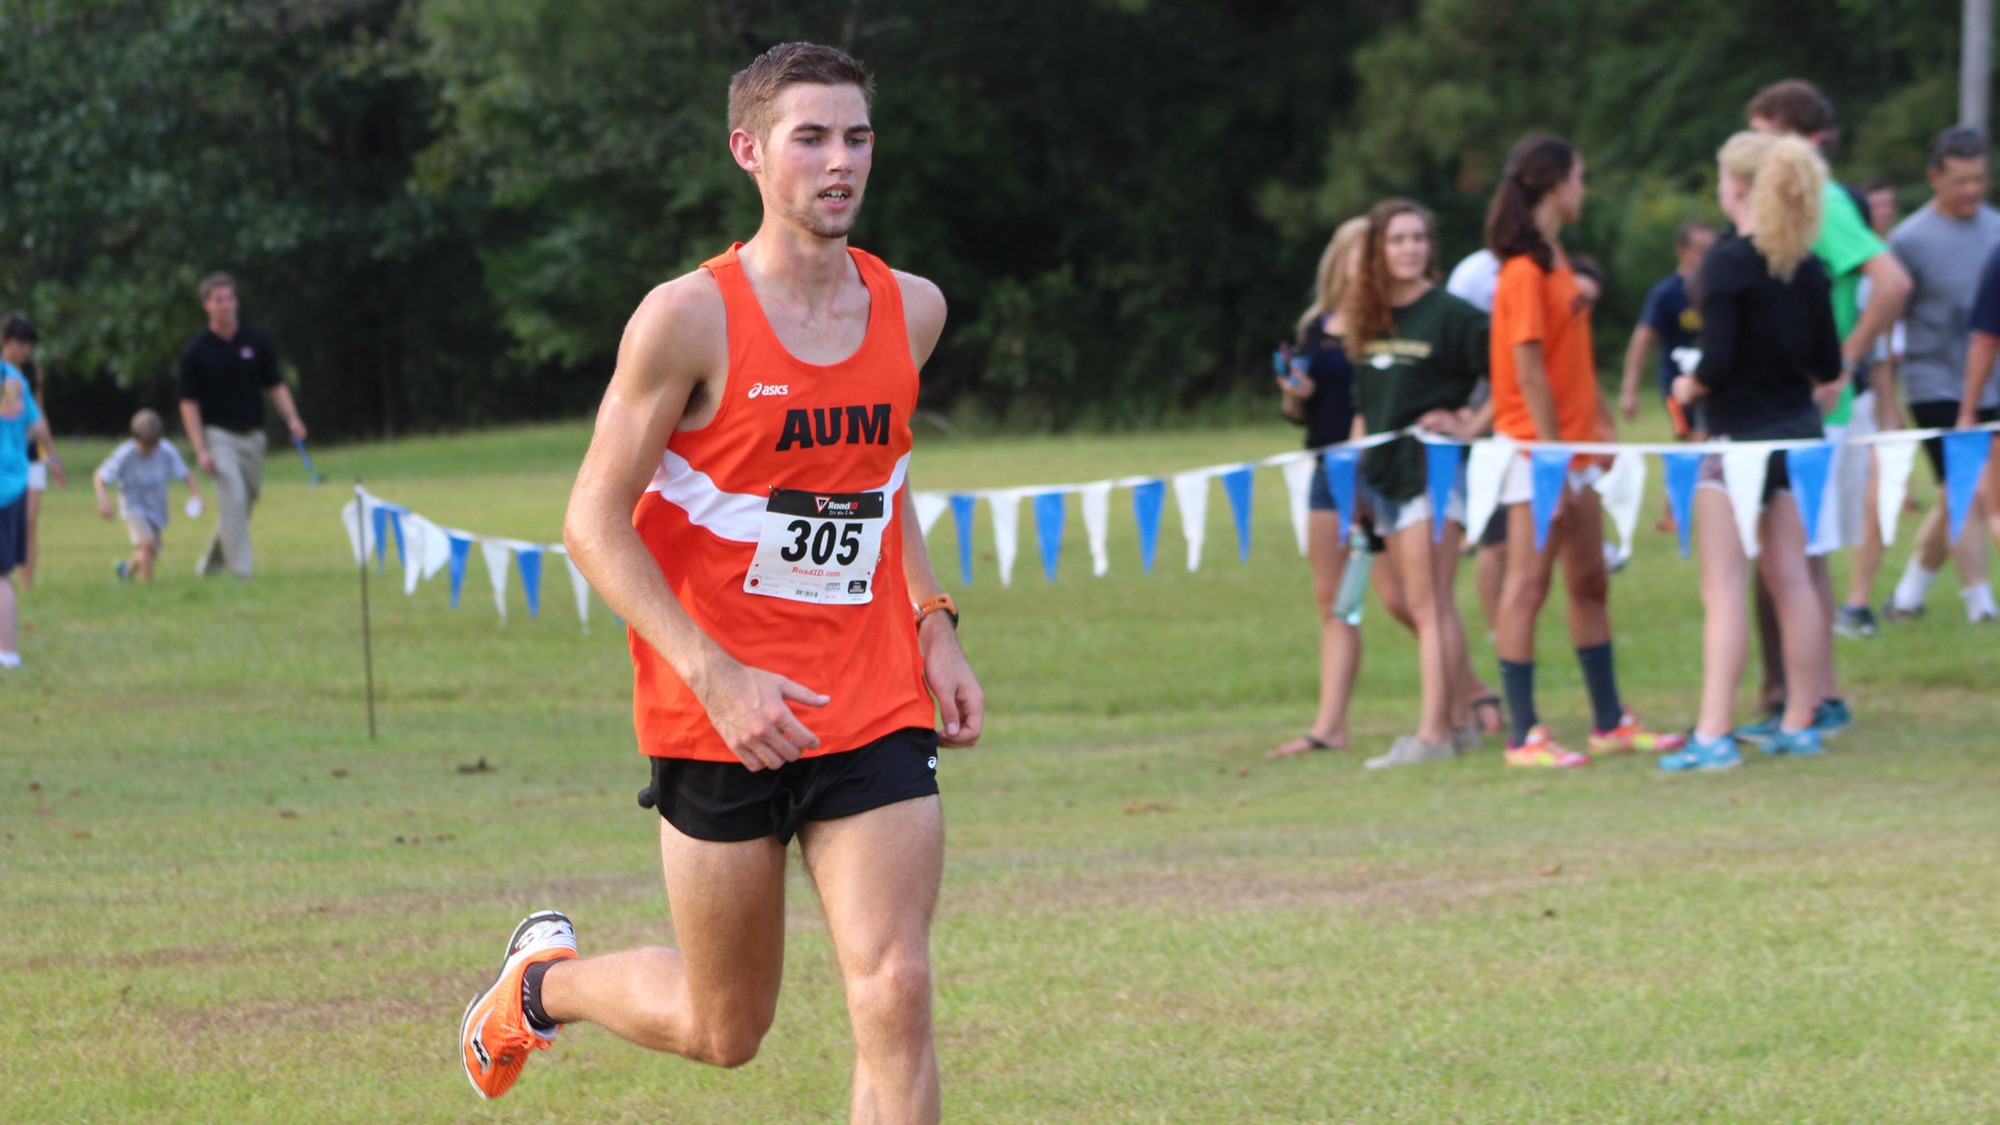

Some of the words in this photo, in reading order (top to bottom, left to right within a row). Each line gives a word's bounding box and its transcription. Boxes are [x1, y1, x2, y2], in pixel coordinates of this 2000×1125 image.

[762, 385, 788, 396] asics
[775, 403, 891, 452] AUM
[828, 501, 859, 510] RoadID
[781, 520, 863, 566] 305
[791, 566, 841, 577] RoadID.com
